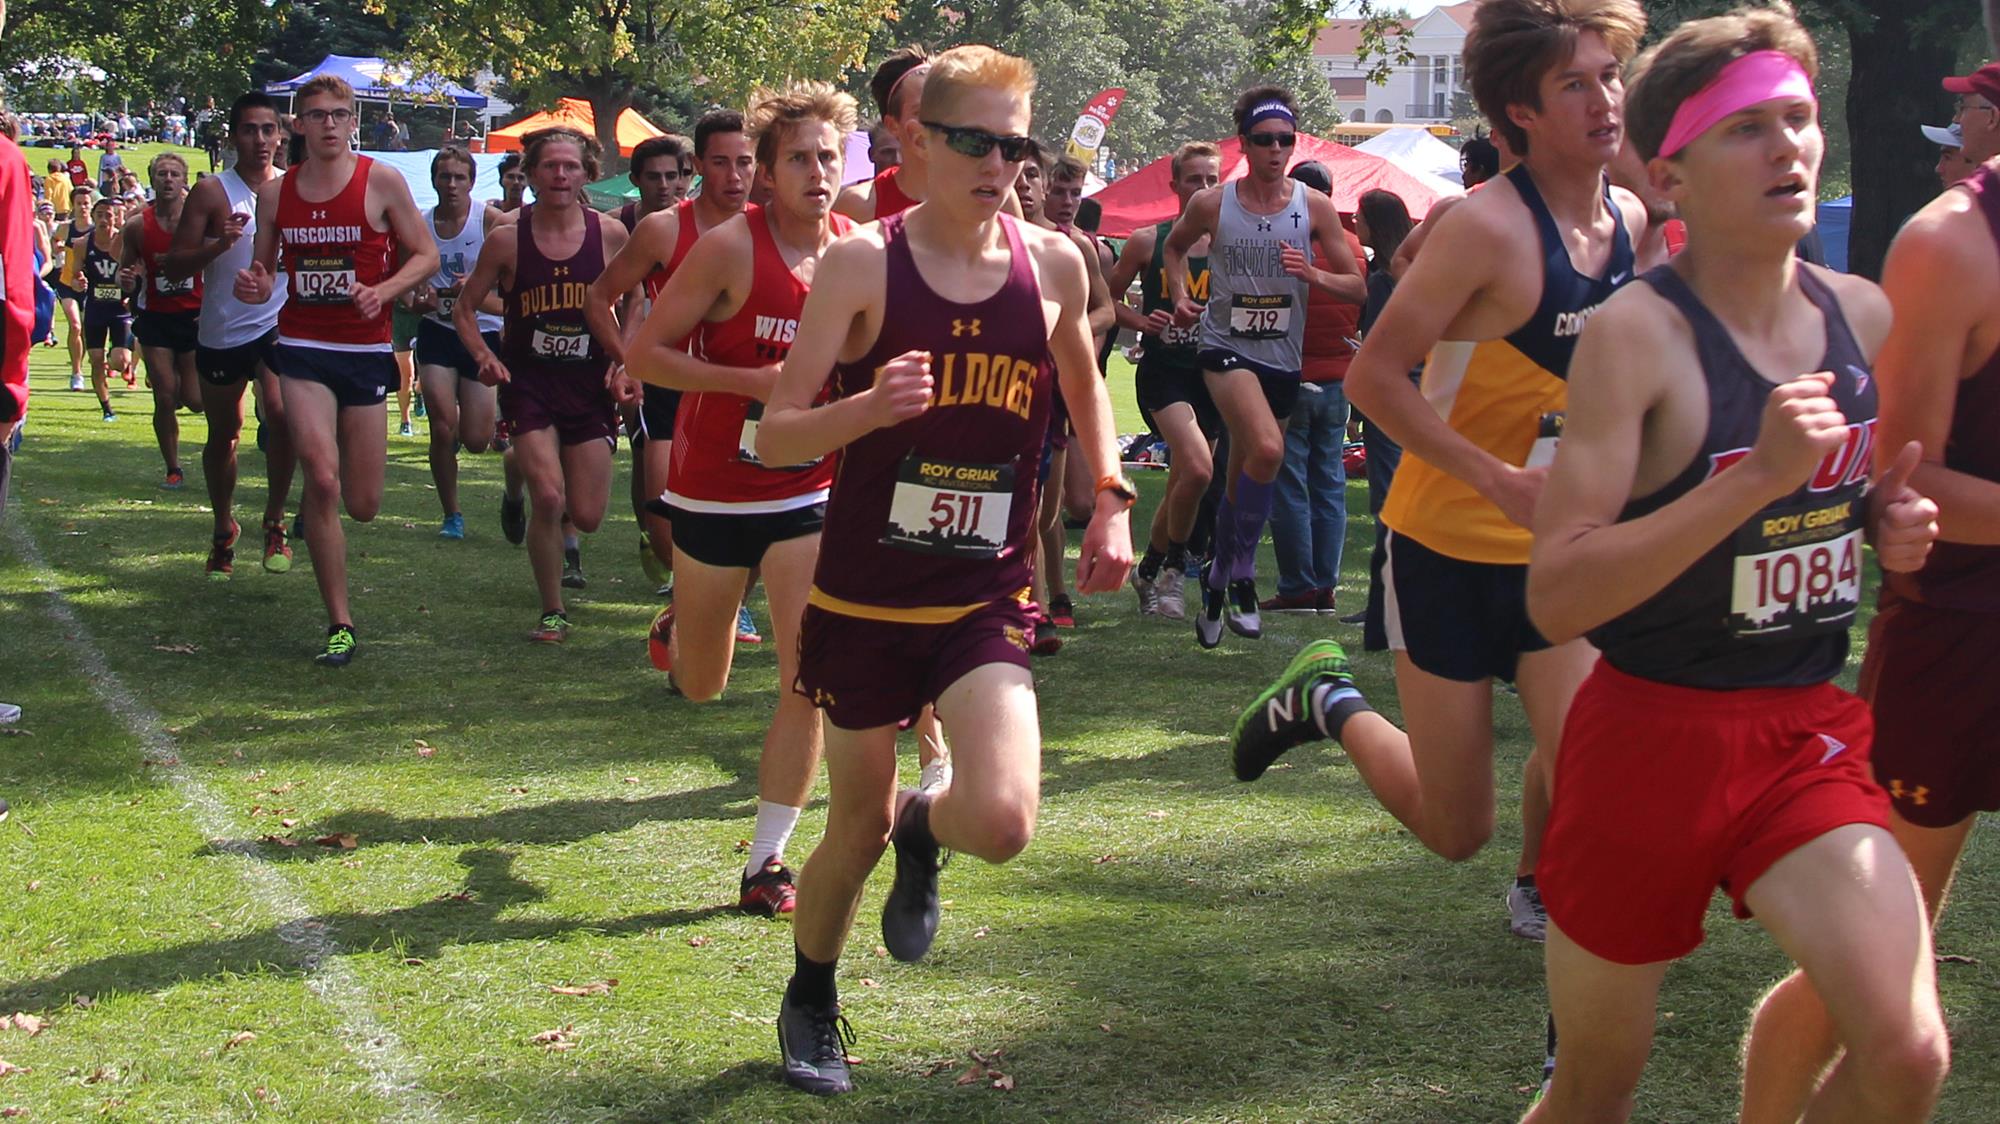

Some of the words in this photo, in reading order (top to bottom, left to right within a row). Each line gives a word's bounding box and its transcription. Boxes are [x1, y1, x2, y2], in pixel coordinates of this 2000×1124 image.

[282, 226, 362, 244] WISCONSIN
[303, 258, 318, 266] ROY
[1223, 245, 1264, 277] SIOUX
[301, 272, 350, 292] 1024
[520, 282, 592, 318] BULLDO
[754, 315, 801, 344] WIS
[1246, 310, 1278, 329] 719
[542, 335, 581, 353] 504
[874, 352, 1038, 420] LDOGS
[920, 462, 954, 478] ROY
[956, 467, 999, 481] GRIAK
[929, 492, 983, 530] 511
[1762, 514, 1802, 537] ROY
[1803, 501, 1851, 528] GRIAK
[1754, 537, 1858, 608] 1084
